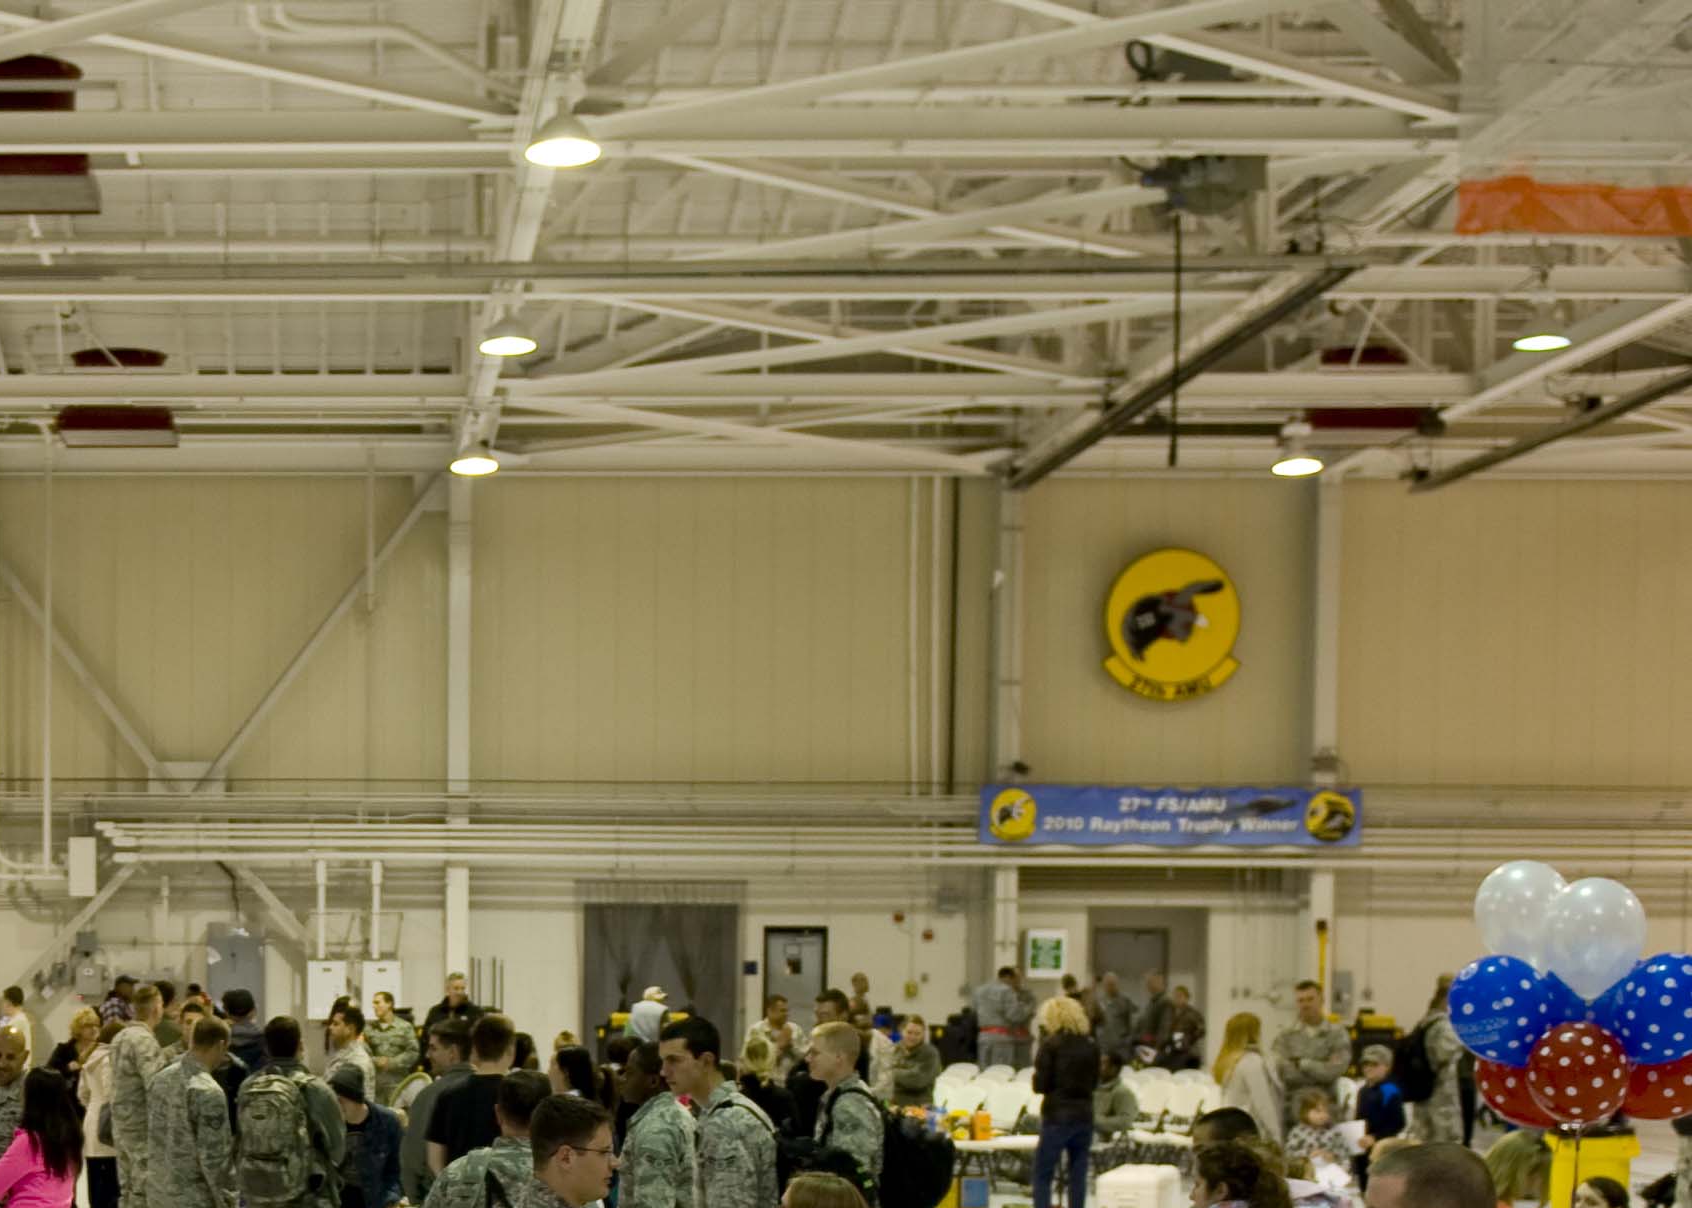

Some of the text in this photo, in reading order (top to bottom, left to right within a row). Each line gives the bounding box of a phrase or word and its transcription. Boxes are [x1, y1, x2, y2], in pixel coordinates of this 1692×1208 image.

[1156, 797, 1227, 813] FS/AMU
[1043, 816, 1299, 835] 2010 Raytheon Trophy Winner
